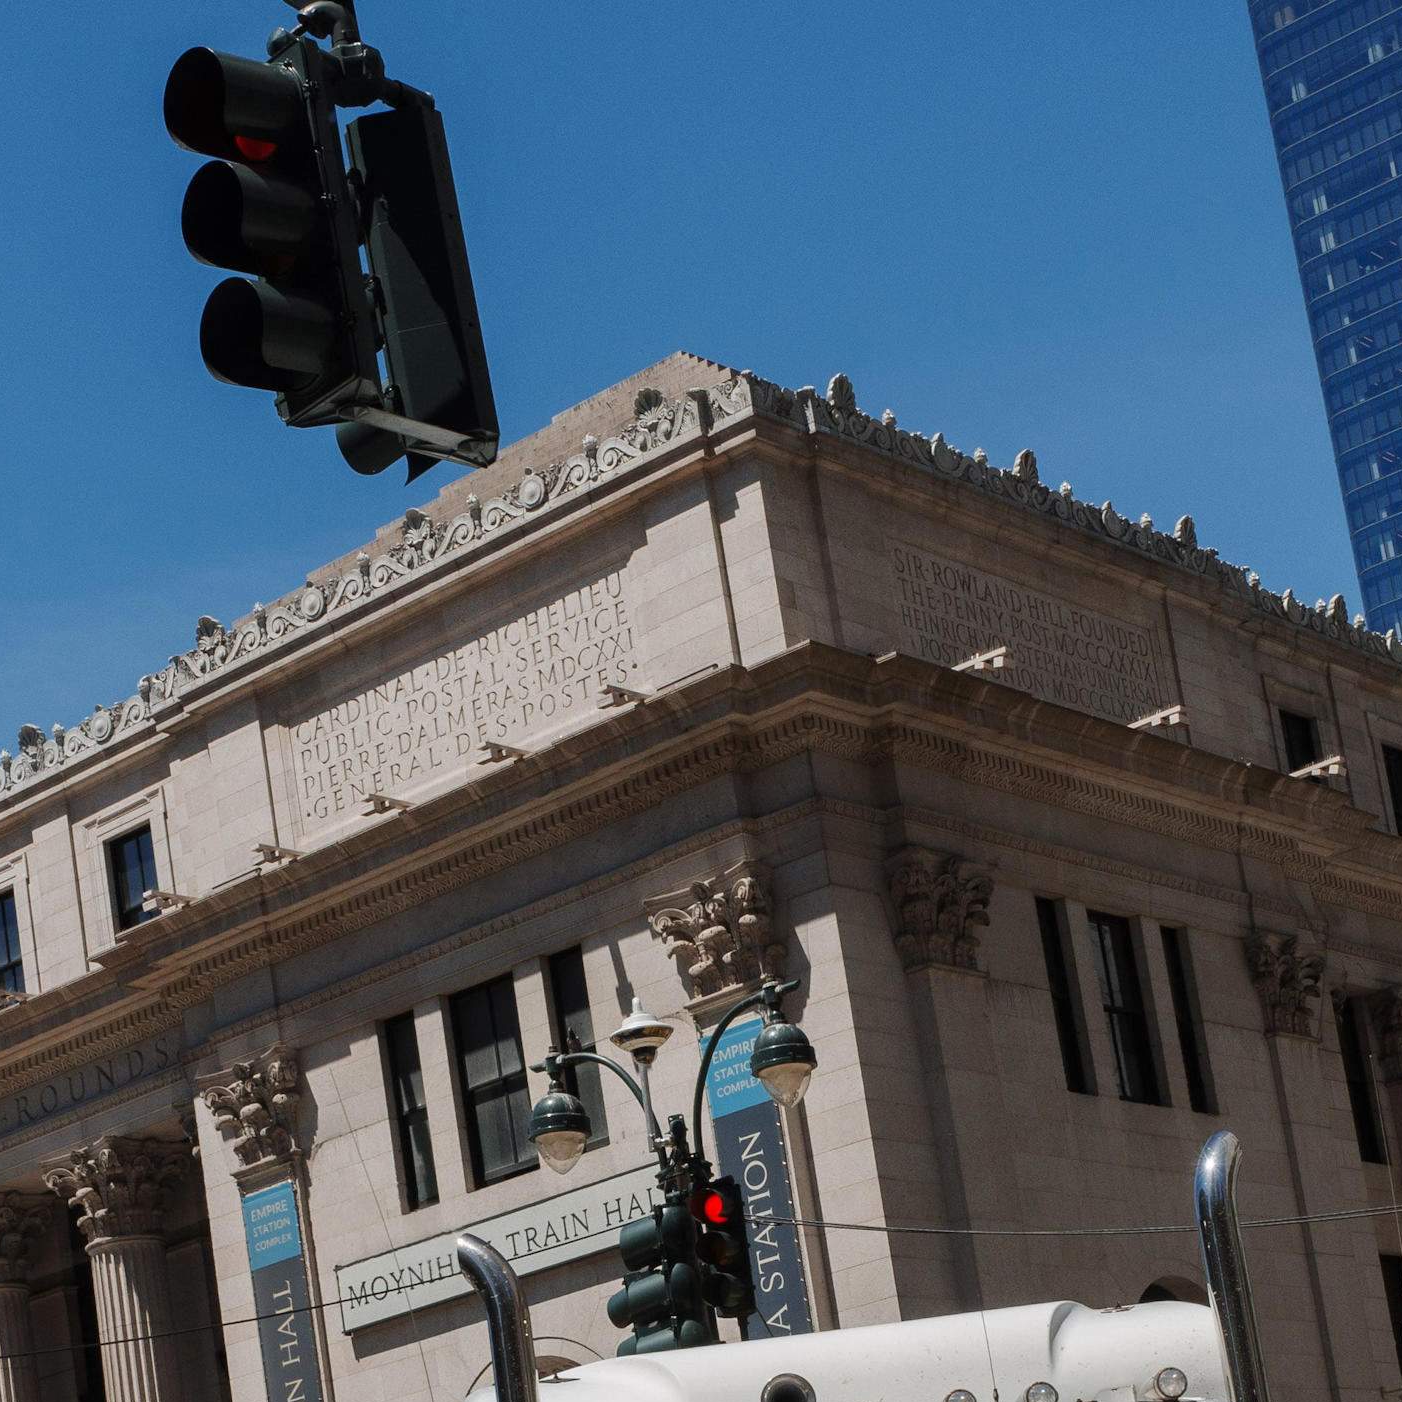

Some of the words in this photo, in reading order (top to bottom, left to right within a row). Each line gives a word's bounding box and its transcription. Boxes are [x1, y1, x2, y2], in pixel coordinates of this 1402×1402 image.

[894, 548, 926, 581] SIR
[930, 560, 1022, 613] ROWLAND
[1026, 595, 1068, 630] HILL
[1070, 611, 1149, 657] FOUNDED
[897, 577, 937, 610] THE
[942, 591, 1004, 633] PENNY
[1010, 615, 1050, 649] POST
[296, 671, 423, 745] CARDINAL
[435, 651, 466, 681] DE
[478, 572, 622, 662] RICHELIEU
[301, 712, 393, 774] PUBLIC
[406, 662, 504, 724] POSTAL
[516, 600, 628, 673] SERVICE
[303, 742, 387, 800] PIERRE
[538, 628, 633, 692] MDCXXI
[456, 714, 508, 756] DES
[522, 659, 628, 727] POSTES
[14, 1036, 173, 1129] ROUNDS
[714, 1060, 751, 1082] STATIO
[716, 1076, 762, 1098] COMPLE
[250, 1199, 288, 1222] EMPIRE
[253, 1216, 291, 1238] STATION
[254, 1232, 294, 1252] COMPLEX
[347, 1250, 468, 1310] MOYNIH
[505, 1208, 591, 1257] TRAIN
[603, 1187, 658, 1228] HAL
[738, 1131, 785, 1294] STATION
[272, 1279, 301, 1368] HALL
